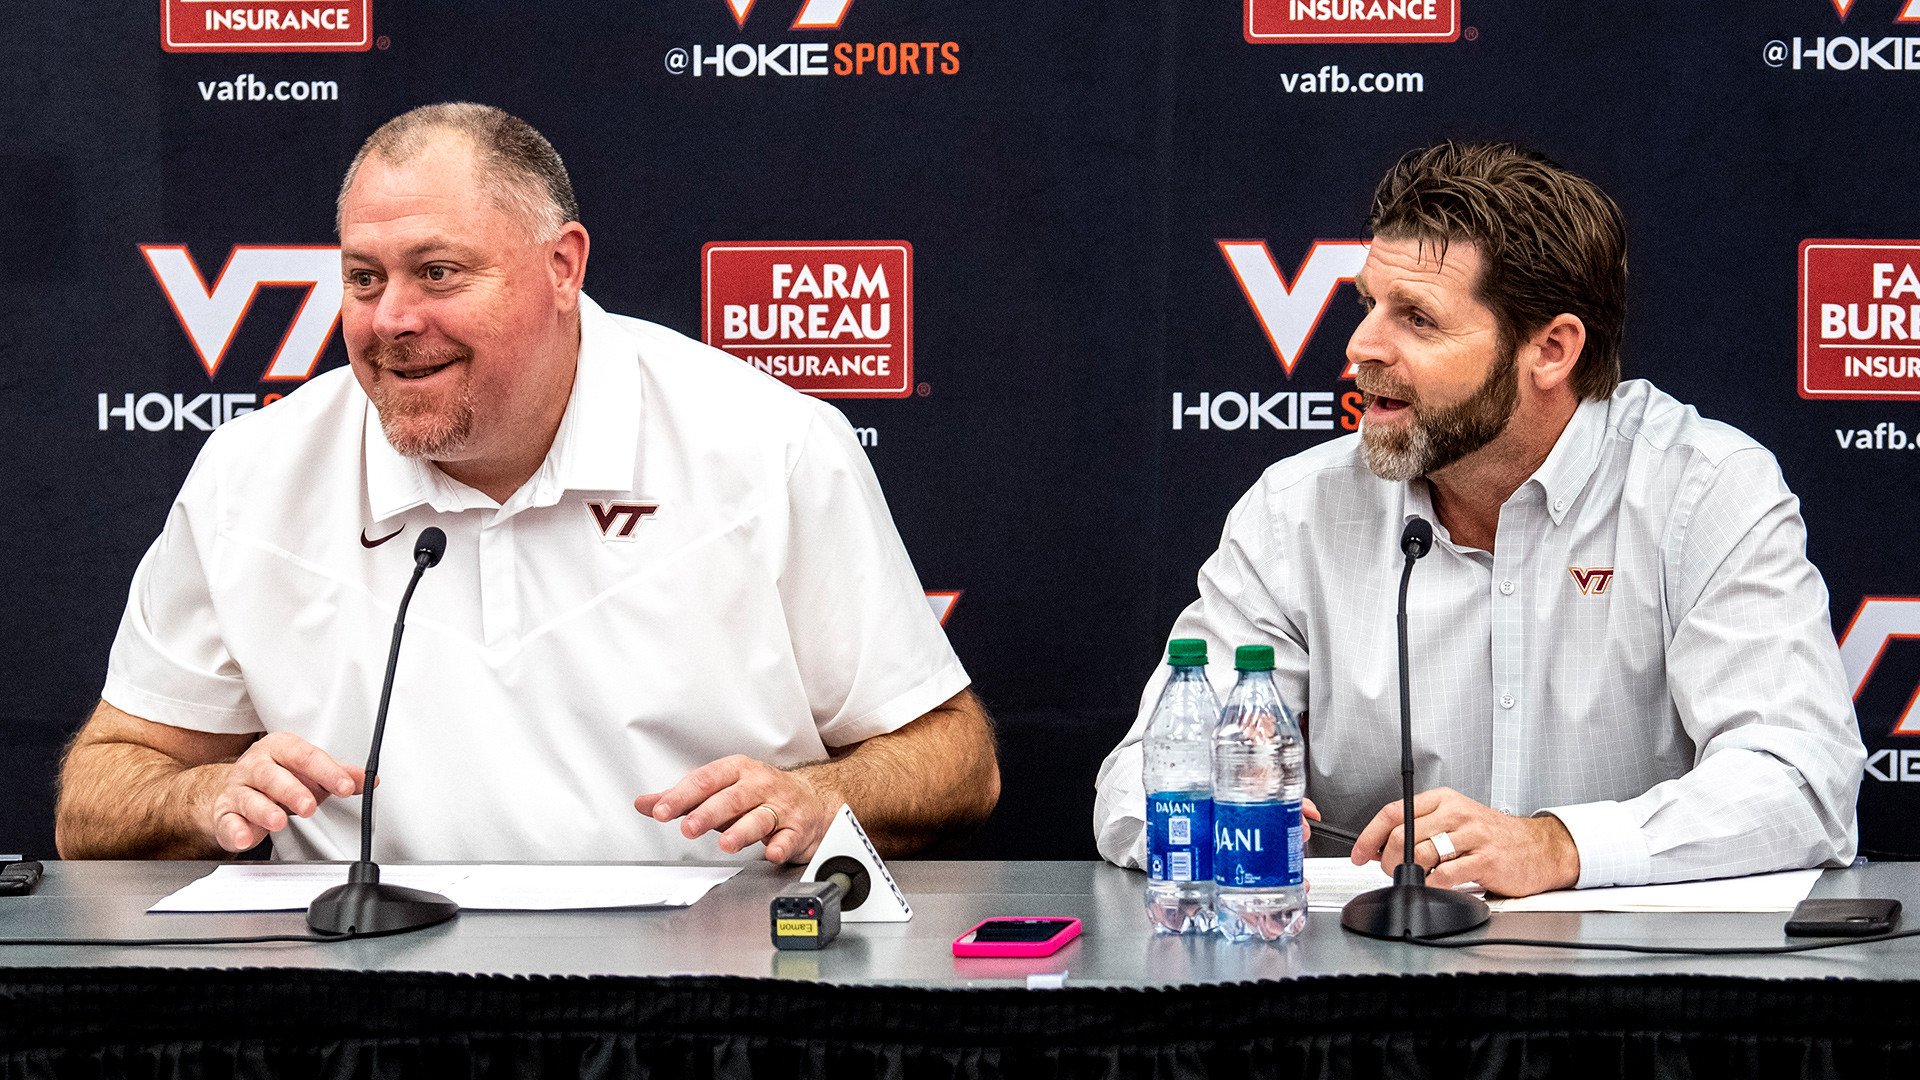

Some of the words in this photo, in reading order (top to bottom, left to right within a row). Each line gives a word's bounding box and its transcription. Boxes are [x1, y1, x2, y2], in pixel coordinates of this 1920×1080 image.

[205, 8, 350, 31] INSURANCE
[1289, 0, 1437, 21] INSURANCE
[197, 73, 339, 101] vafb.com
[1280, 65, 1424, 93] vafb.com
[772, 263, 890, 300] FARM
[723, 303, 891, 340] BUREAU
[98, 392, 283, 431] HOKIE
[587, 502, 660, 537] VT
[1568, 566, 1614, 596] VT
[1155, 800, 1196, 816] DASANI
[779, 923, 813, 933] Eamon
